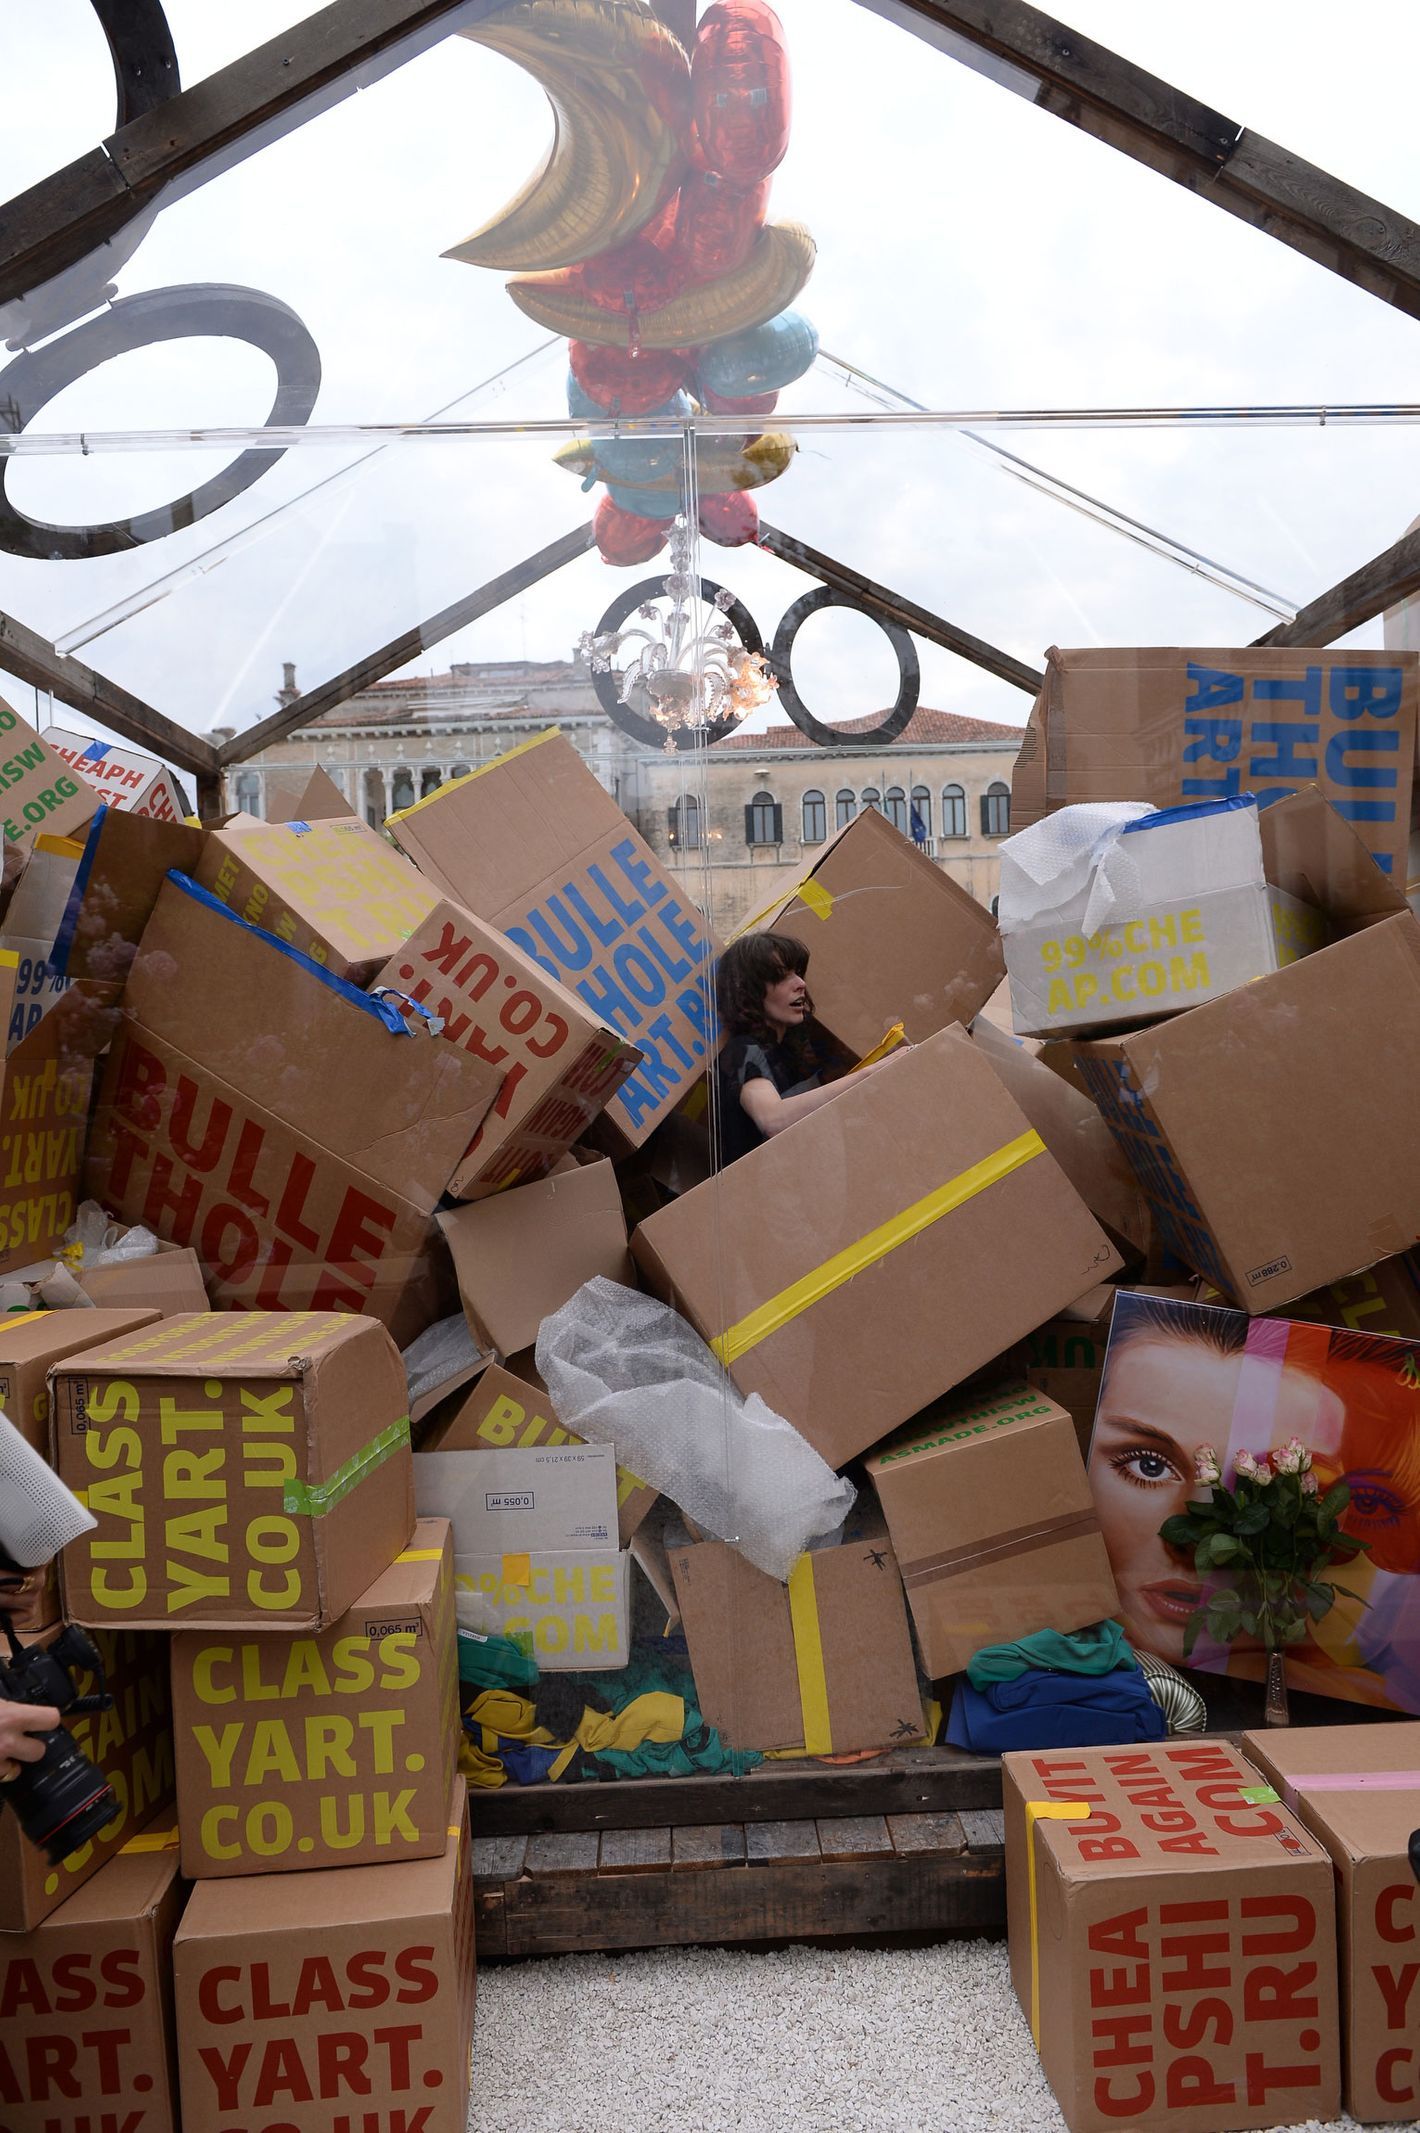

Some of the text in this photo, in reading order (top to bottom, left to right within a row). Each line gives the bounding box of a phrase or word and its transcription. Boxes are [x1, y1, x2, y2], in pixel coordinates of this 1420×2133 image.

[1250, 666, 1322, 812] TH
[1324, 666, 1403, 874] BUL
[421, 921, 569, 1059] CO.UK
[1040, 908, 1206, 974] 99%CHE
[1047, 951, 1211, 1015] AP.COM
[10, 1075, 87, 1121] COUK
[3, 1127, 79, 1188] YART.
[116, 1039, 398, 1291] BULLE
[879, 1405, 1051, 1465] ASMADE.ORG
[85, 1380, 147, 1610] CLASS
[160, 1379, 230, 1613] YART.
[239, 1387, 302, 1610] COUK
[192, 1632, 421, 1705] CLASS
[192, 1709, 425, 1789] YART.
[201, 1788, 419, 1860] CO.UK
[1103, 1754, 1220, 1856] AGAIN
[198, 1945, 440, 2026] CLASS
[1087, 1906, 1156, 2118] CHEA
[1159, 1899, 1237, 2109] PSHI
[1240, 1894, 1322, 2107] T.RU
[198, 2024, 444, 2112] YART.
